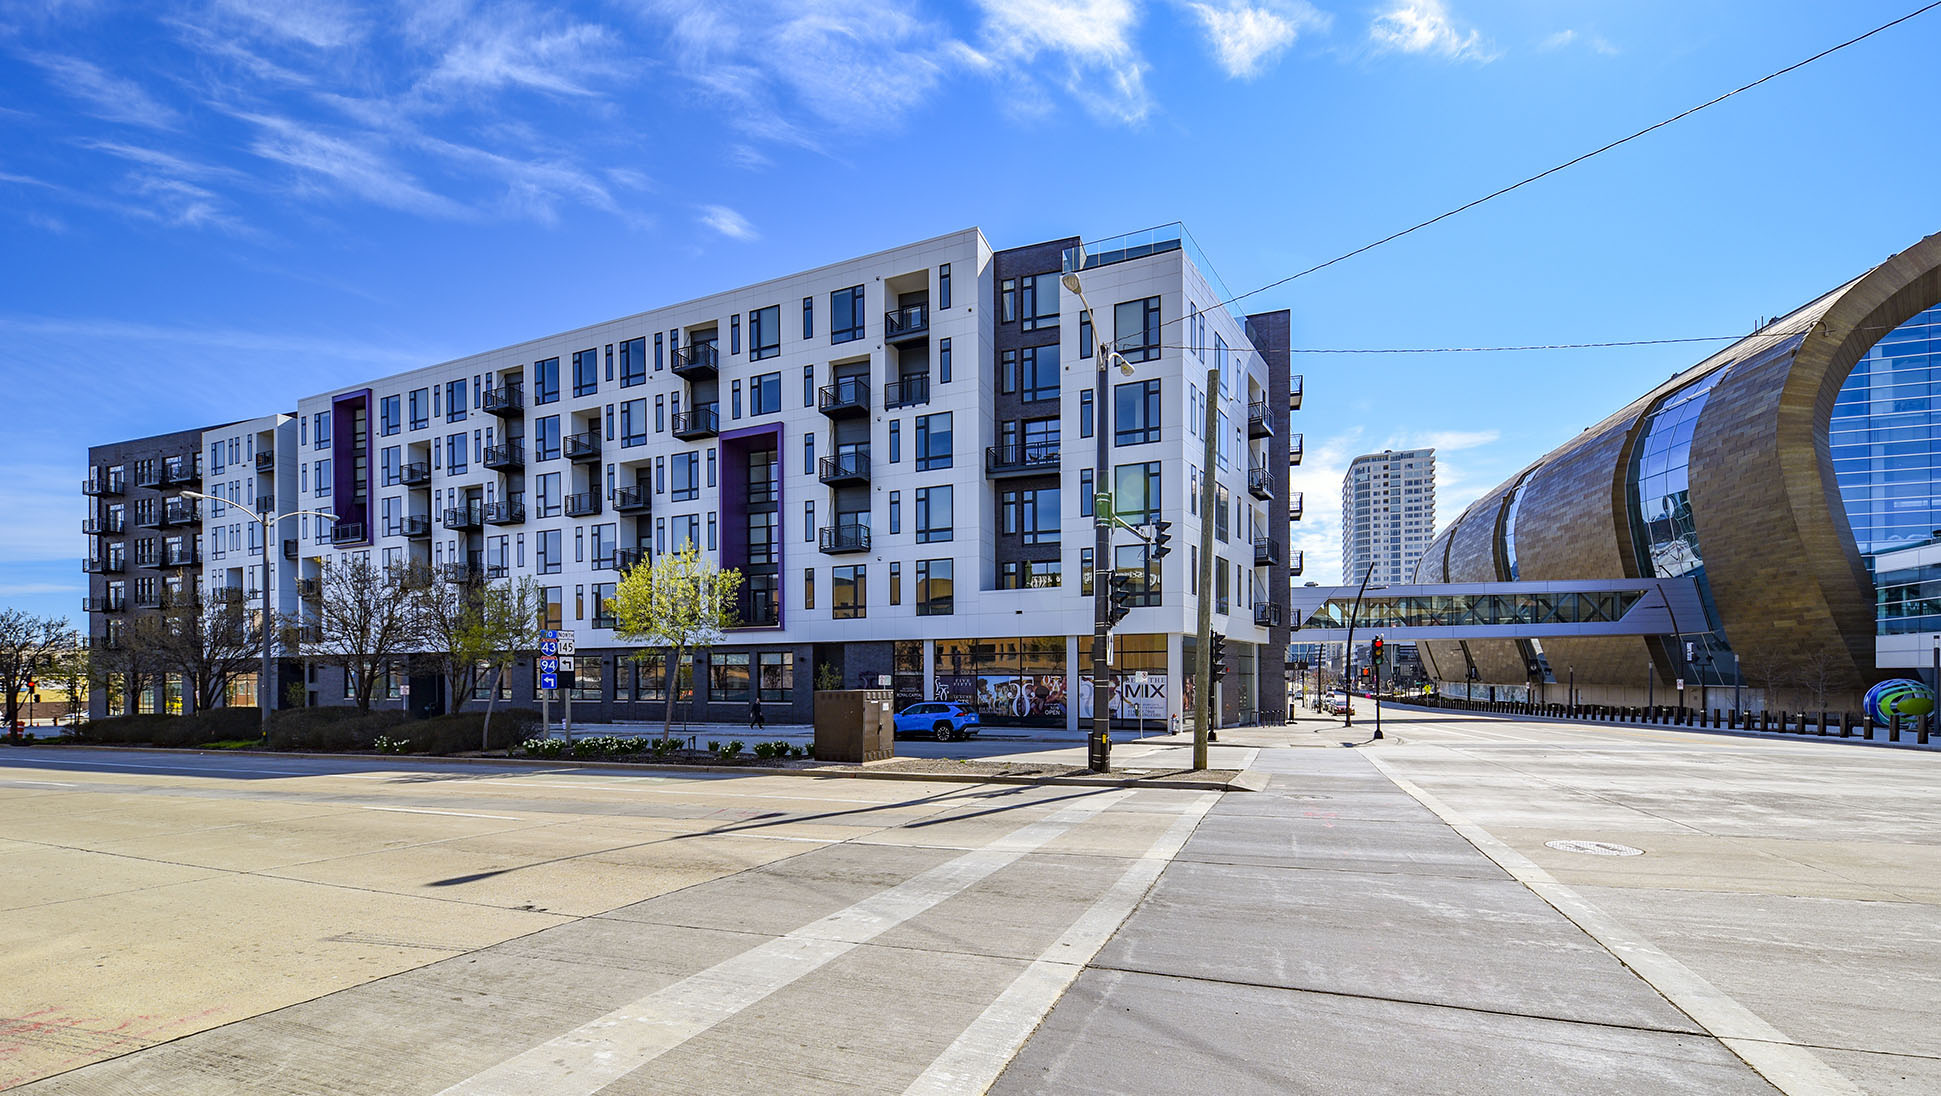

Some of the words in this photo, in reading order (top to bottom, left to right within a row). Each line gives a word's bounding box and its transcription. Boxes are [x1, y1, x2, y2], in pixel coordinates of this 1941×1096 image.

[542, 642, 556, 652] 43
[559, 642, 573, 652] 145
[541, 660, 555, 670] 94
[1125, 684, 1165, 698] MIX
